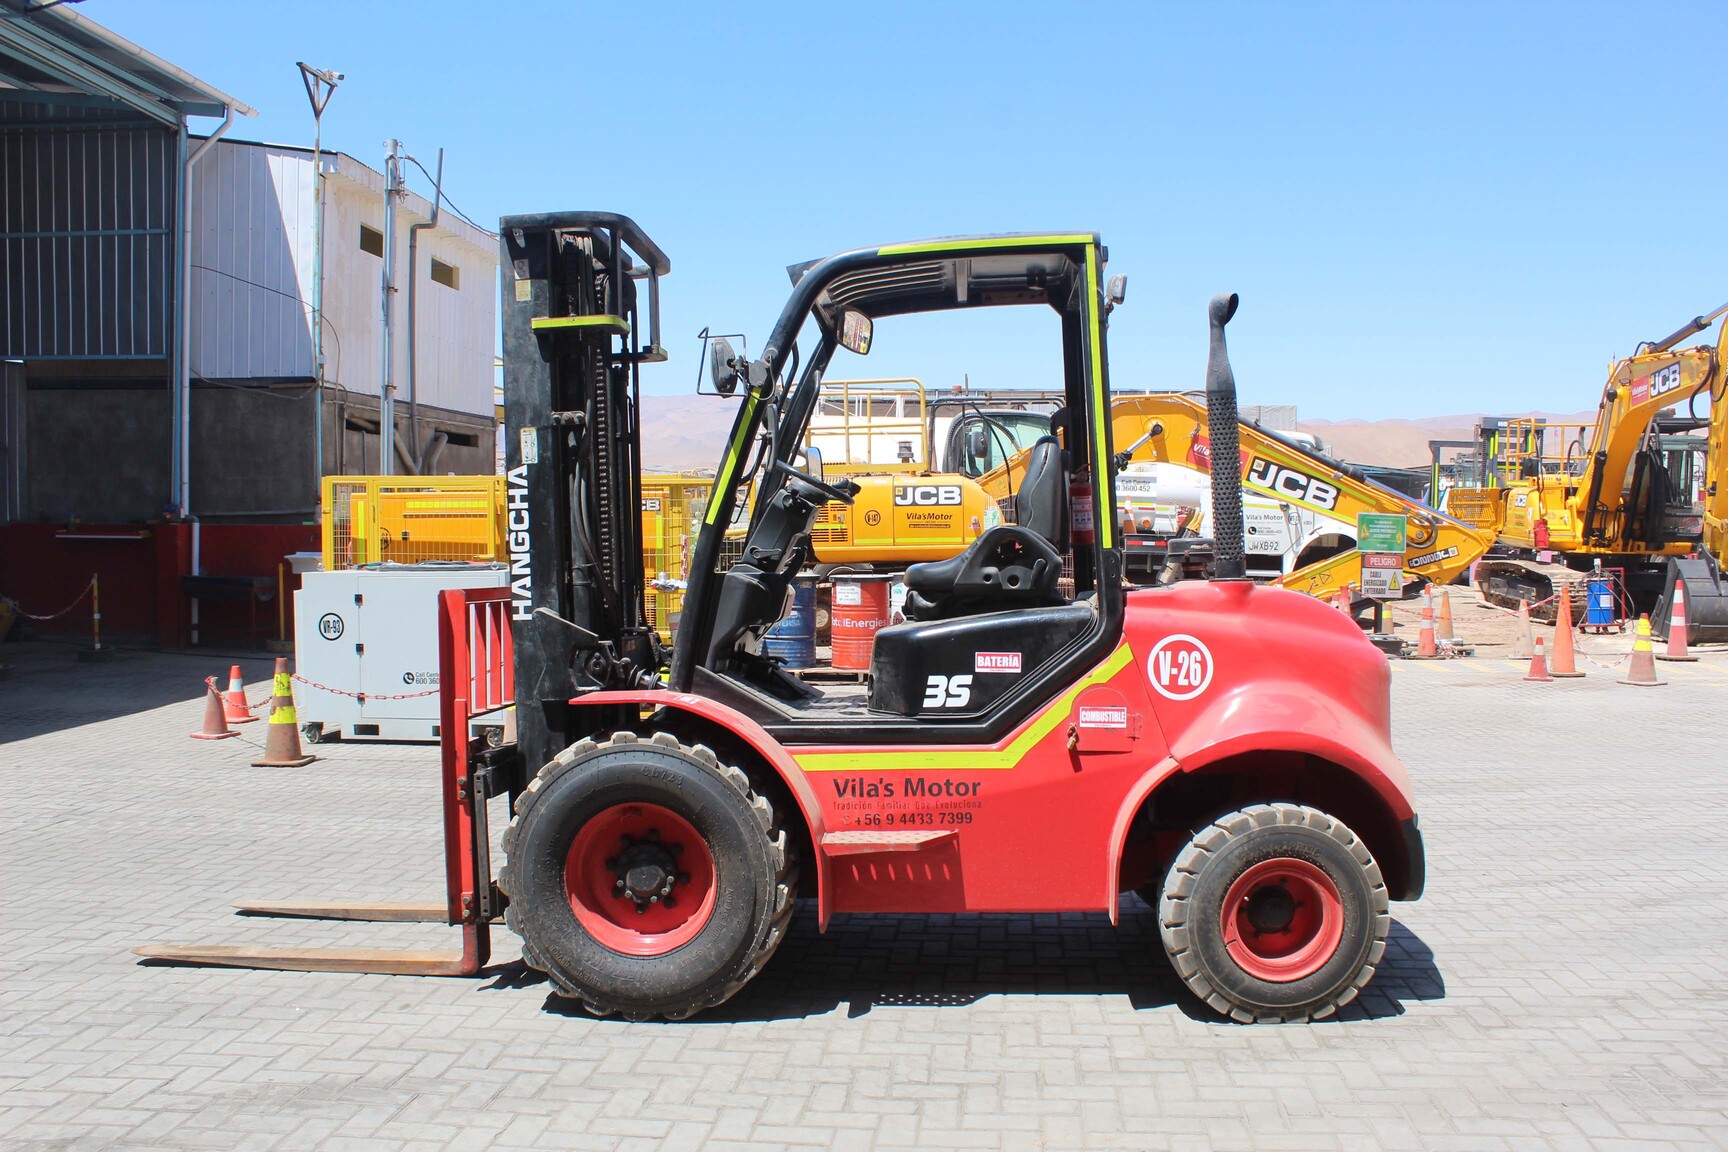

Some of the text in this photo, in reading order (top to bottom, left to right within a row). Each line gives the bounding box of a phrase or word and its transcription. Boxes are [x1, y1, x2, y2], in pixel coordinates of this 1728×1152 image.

[1651, 363, 1680, 397] JCB
[1249, 464, 1338, 510] JCB
[895, 486, 961, 506] JCB
[507, 464, 533, 621] HANGCHA
[1369, 557, 1397, 566] PELIGRO
[322, 619, 341, 634] VR-93
[977, 654, 1020, 668] BATERÍA
[1158, 650, 1202, 687] V-26
[415, 677, 428, 685] 600
[1081, 710, 1126, 723] COMBUSTIBLE
[833, 777, 981, 798] Vila's Motor
[855, 812, 973, 826] +56 9 4433 7399
